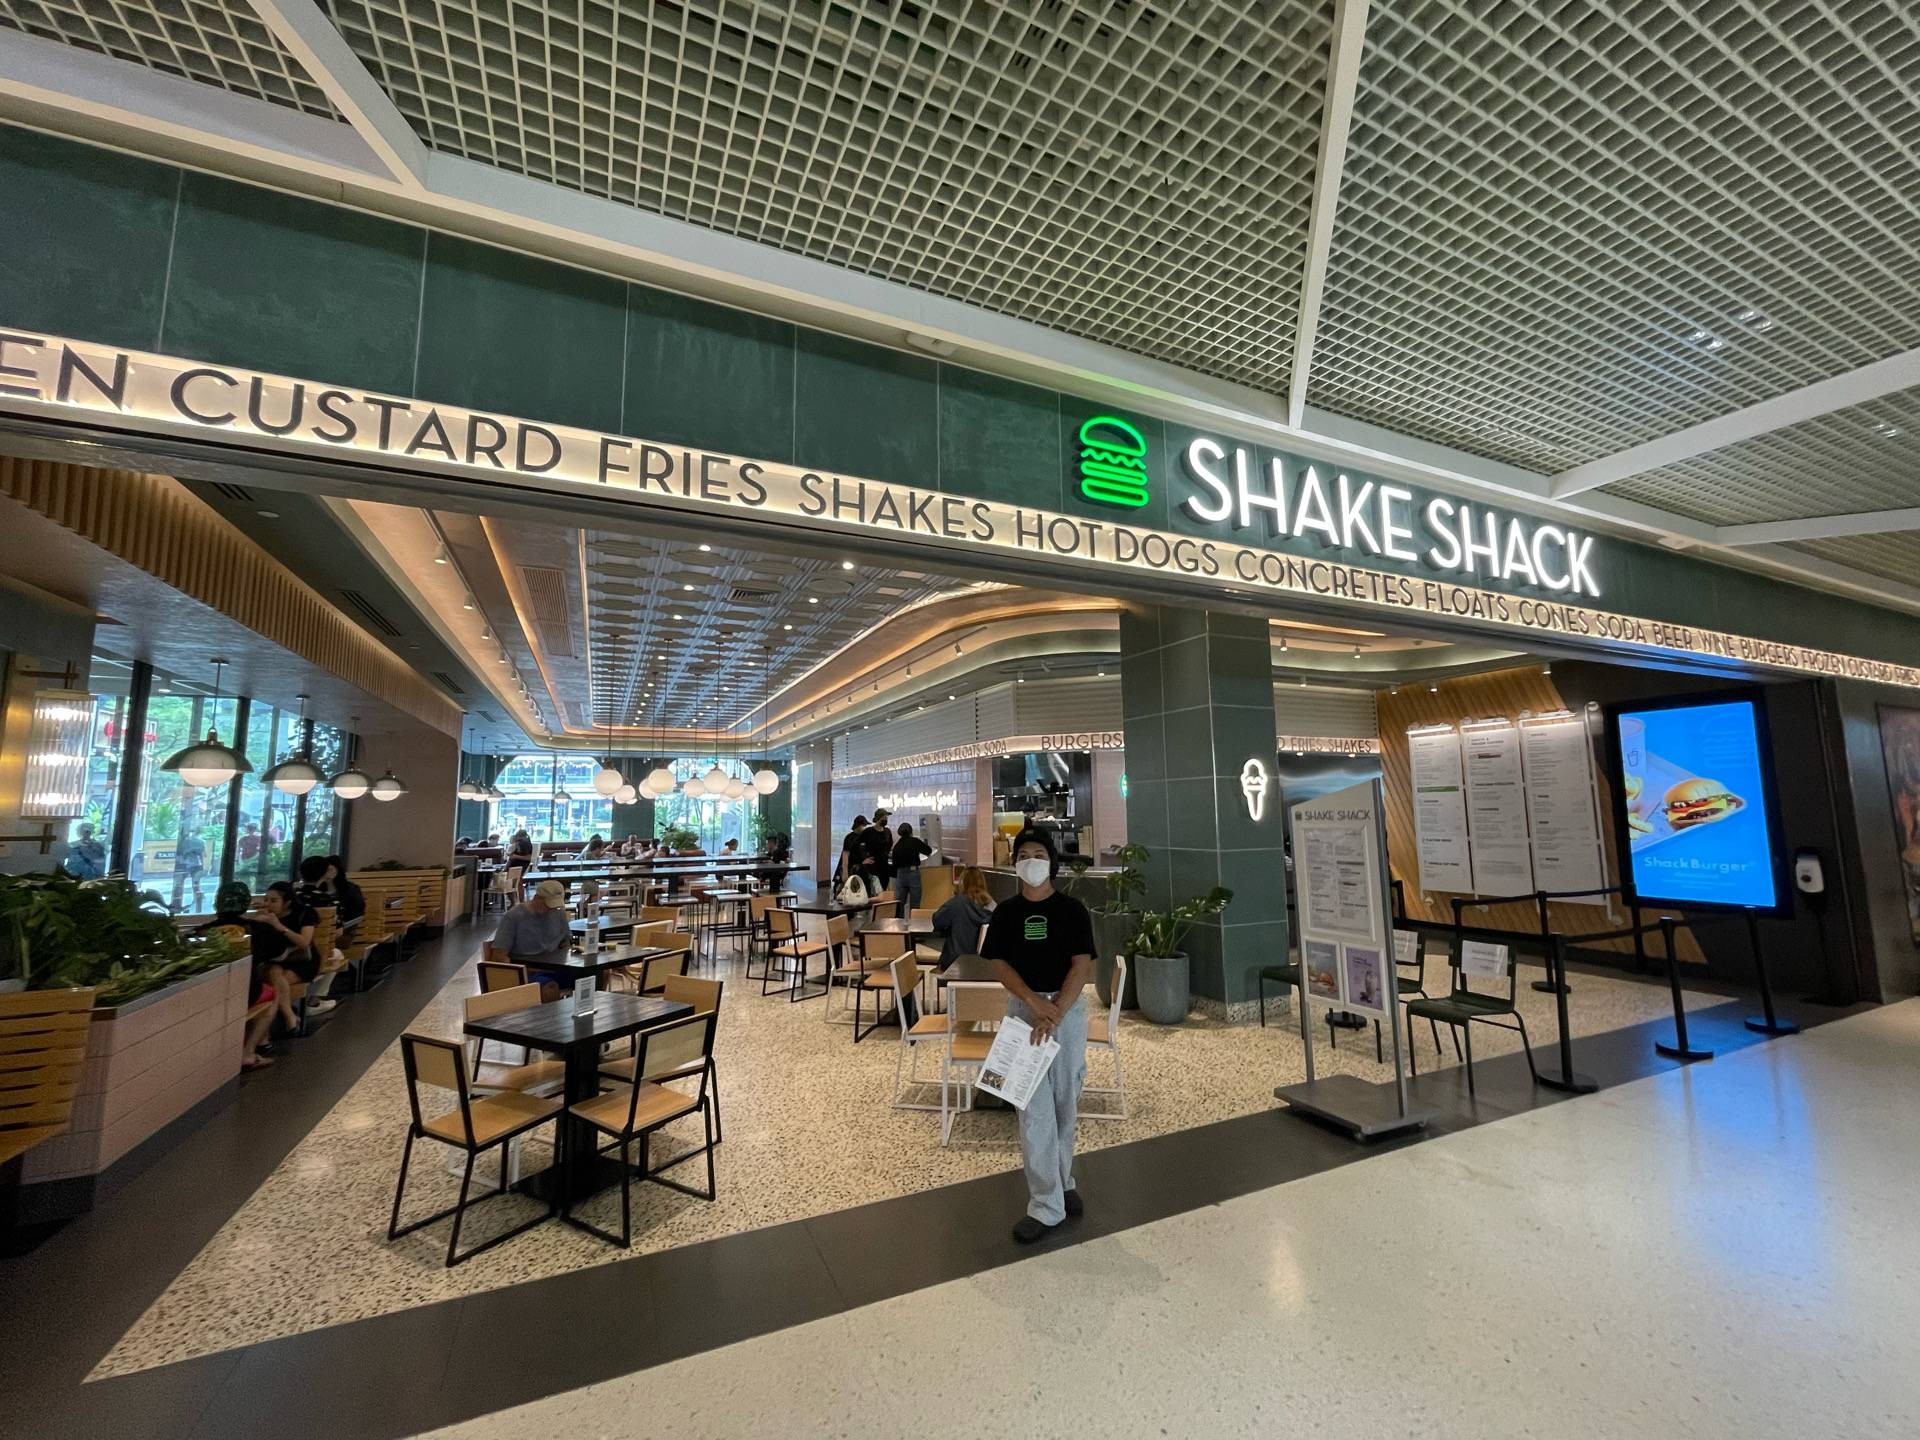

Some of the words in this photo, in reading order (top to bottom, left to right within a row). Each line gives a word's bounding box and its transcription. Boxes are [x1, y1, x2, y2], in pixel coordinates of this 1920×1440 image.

[0, 333, 128, 411] EN
[171, 369, 562, 473] CUSTARD
[599, 437, 768, 506] FRIES
[798, 473, 995, 541] SHAKES
[1017, 510, 1103, 562] HOT
[1113, 529, 1220, 576] DOGS
[1235, 549, 1414, 609] CONCRETES
[1424, 582, 1510, 622] FLOATS
[1518, 600, 1590, 635] CONES
[1596, 614, 1647, 643] SODA
[1652, 622, 1693, 650] BEER
[1700, 632, 1737, 658] WINE
[1739, 638, 1799, 667] BURGERS
[1801, 649, 1844, 674] FROZEN
[1186, 438, 1418, 563] SHAKE
[1426, 498, 1600, 597] SHACK
[984, 740, 1007, 755] SODA
[1041, 732, 1124, 750] BURGERS
[1291, 737, 1323, 751] FRIES
[1328, 739, 1371, 753] SHAKES
[1305, 810, 1335, 821] SHAKE
[1337, 809, 1372, 821] SHACK
